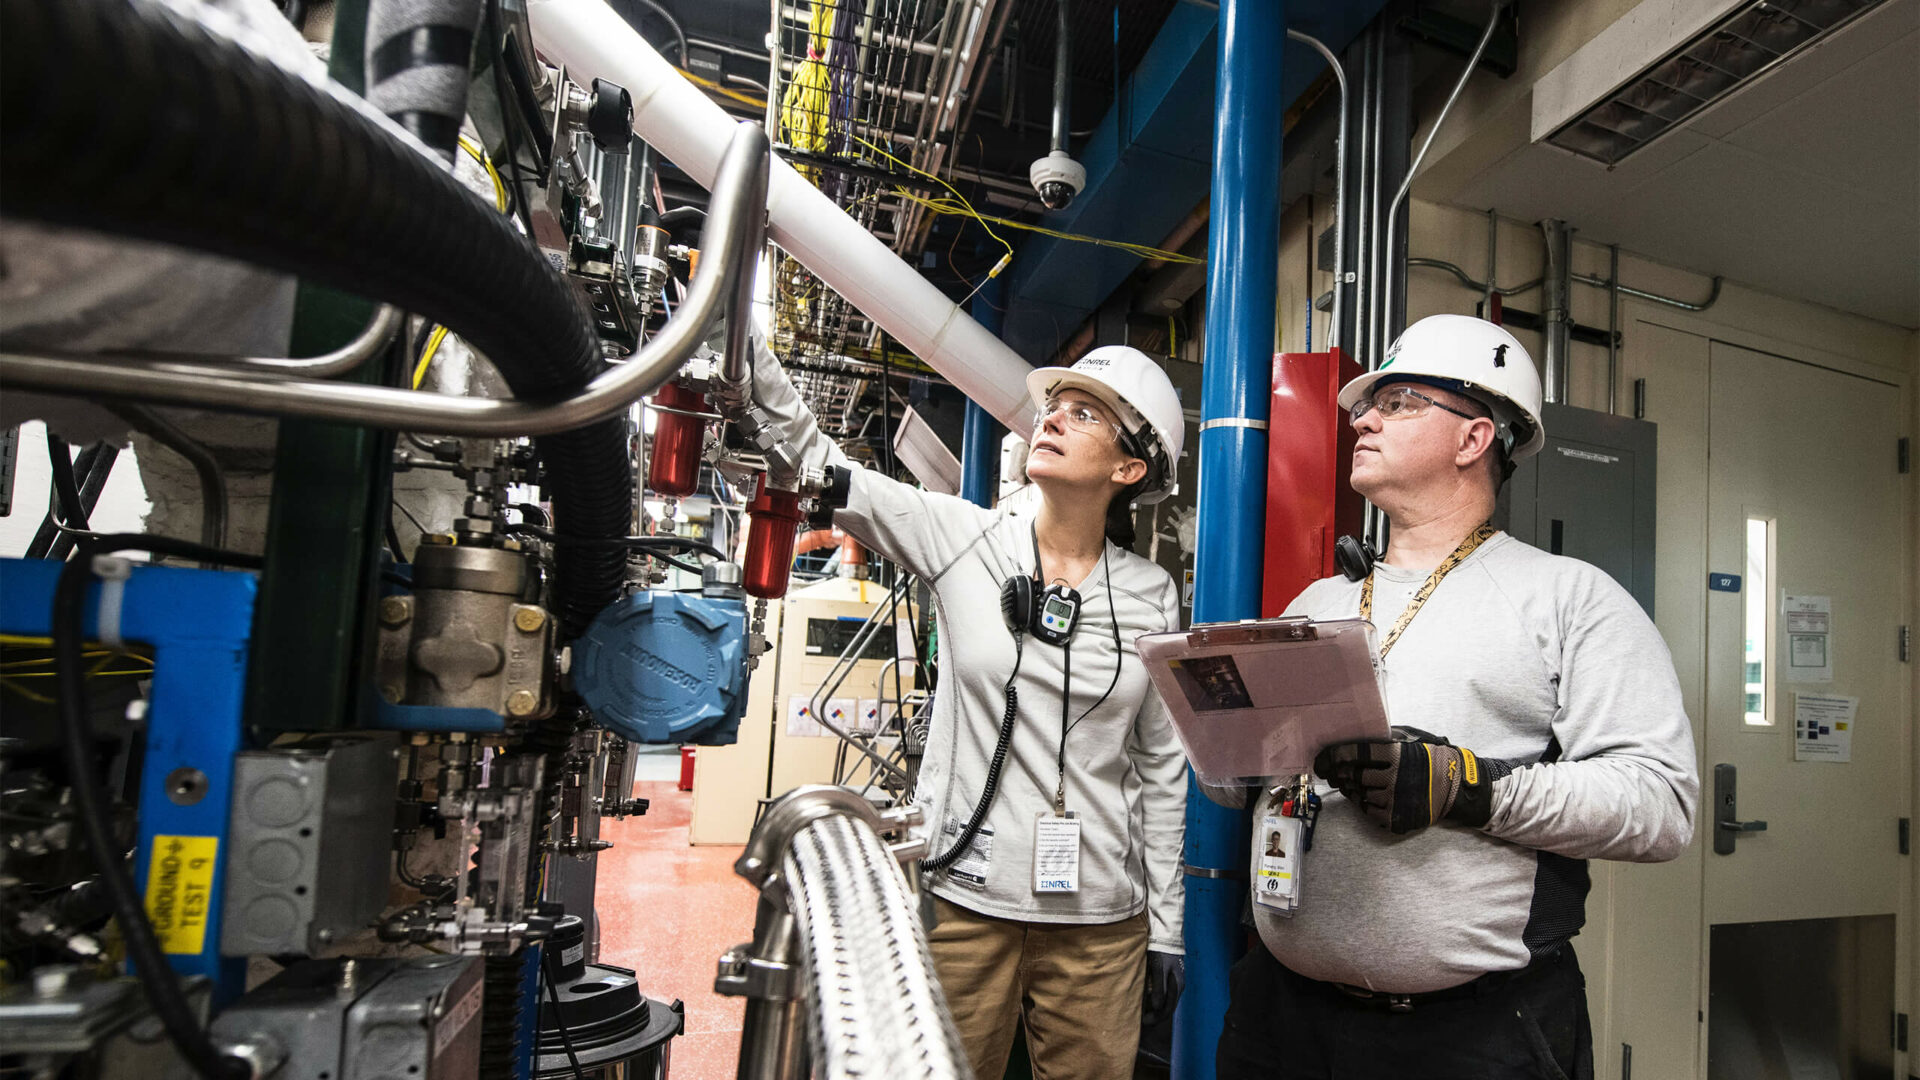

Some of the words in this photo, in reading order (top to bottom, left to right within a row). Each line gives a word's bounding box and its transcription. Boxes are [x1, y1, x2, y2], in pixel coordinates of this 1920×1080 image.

[1084, 359, 1111, 367] NREL
[620, 642, 703, 694] ROSEMOUNT
[154, 856, 181, 931] GROUND
[181, 884, 205, 927] TEST
[1048, 880, 1072, 888] NREL
